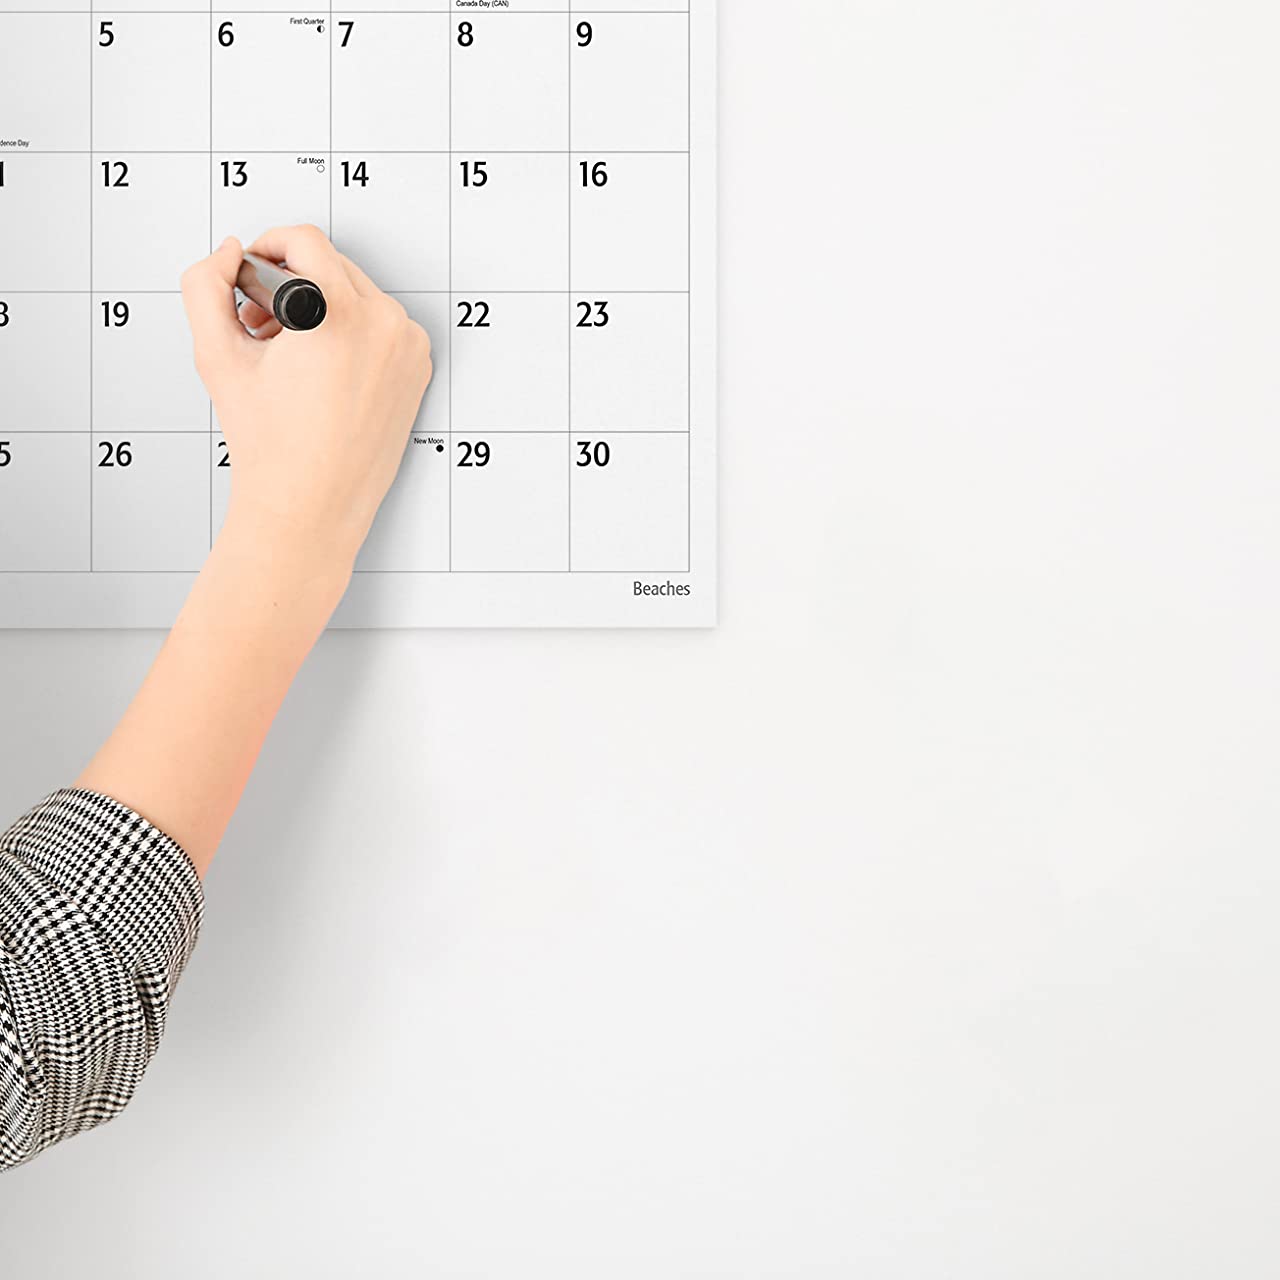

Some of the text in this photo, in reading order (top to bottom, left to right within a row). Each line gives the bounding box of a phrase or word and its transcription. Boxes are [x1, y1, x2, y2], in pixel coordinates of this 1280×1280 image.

[455, 0, 510, 9] Canada Day (CAN)
[99, 22, 114, 47] 5
[218, 22, 234, 47] 6
[289, 17, 325, 27] First Quarter
[339, 22, 354, 47] 7
[458, 22, 473, 47] 8
[577, 22, 592, 47] 9
[15, 138, 30, 148] Day
[296, 156, 325, 165] Full Moon
[102, 161, 129, 187] 12
[221, 161, 247, 187] 13
[341, 161, 369, 187] 14
[460, 161, 487, 187] 15
[580, 161, 607, 187] 16
[102, 301, 129, 327] 19
[457, 302, 490, 327] 22
[576, 301, 608, 327] 23
[413, 437, 445, 445] New Moon
[577, 441, 610, 466] 30
[98, 442, 132, 467] 26
[457, 442, 490, 467] 29
[633, 580, 691, 596] Beaches
